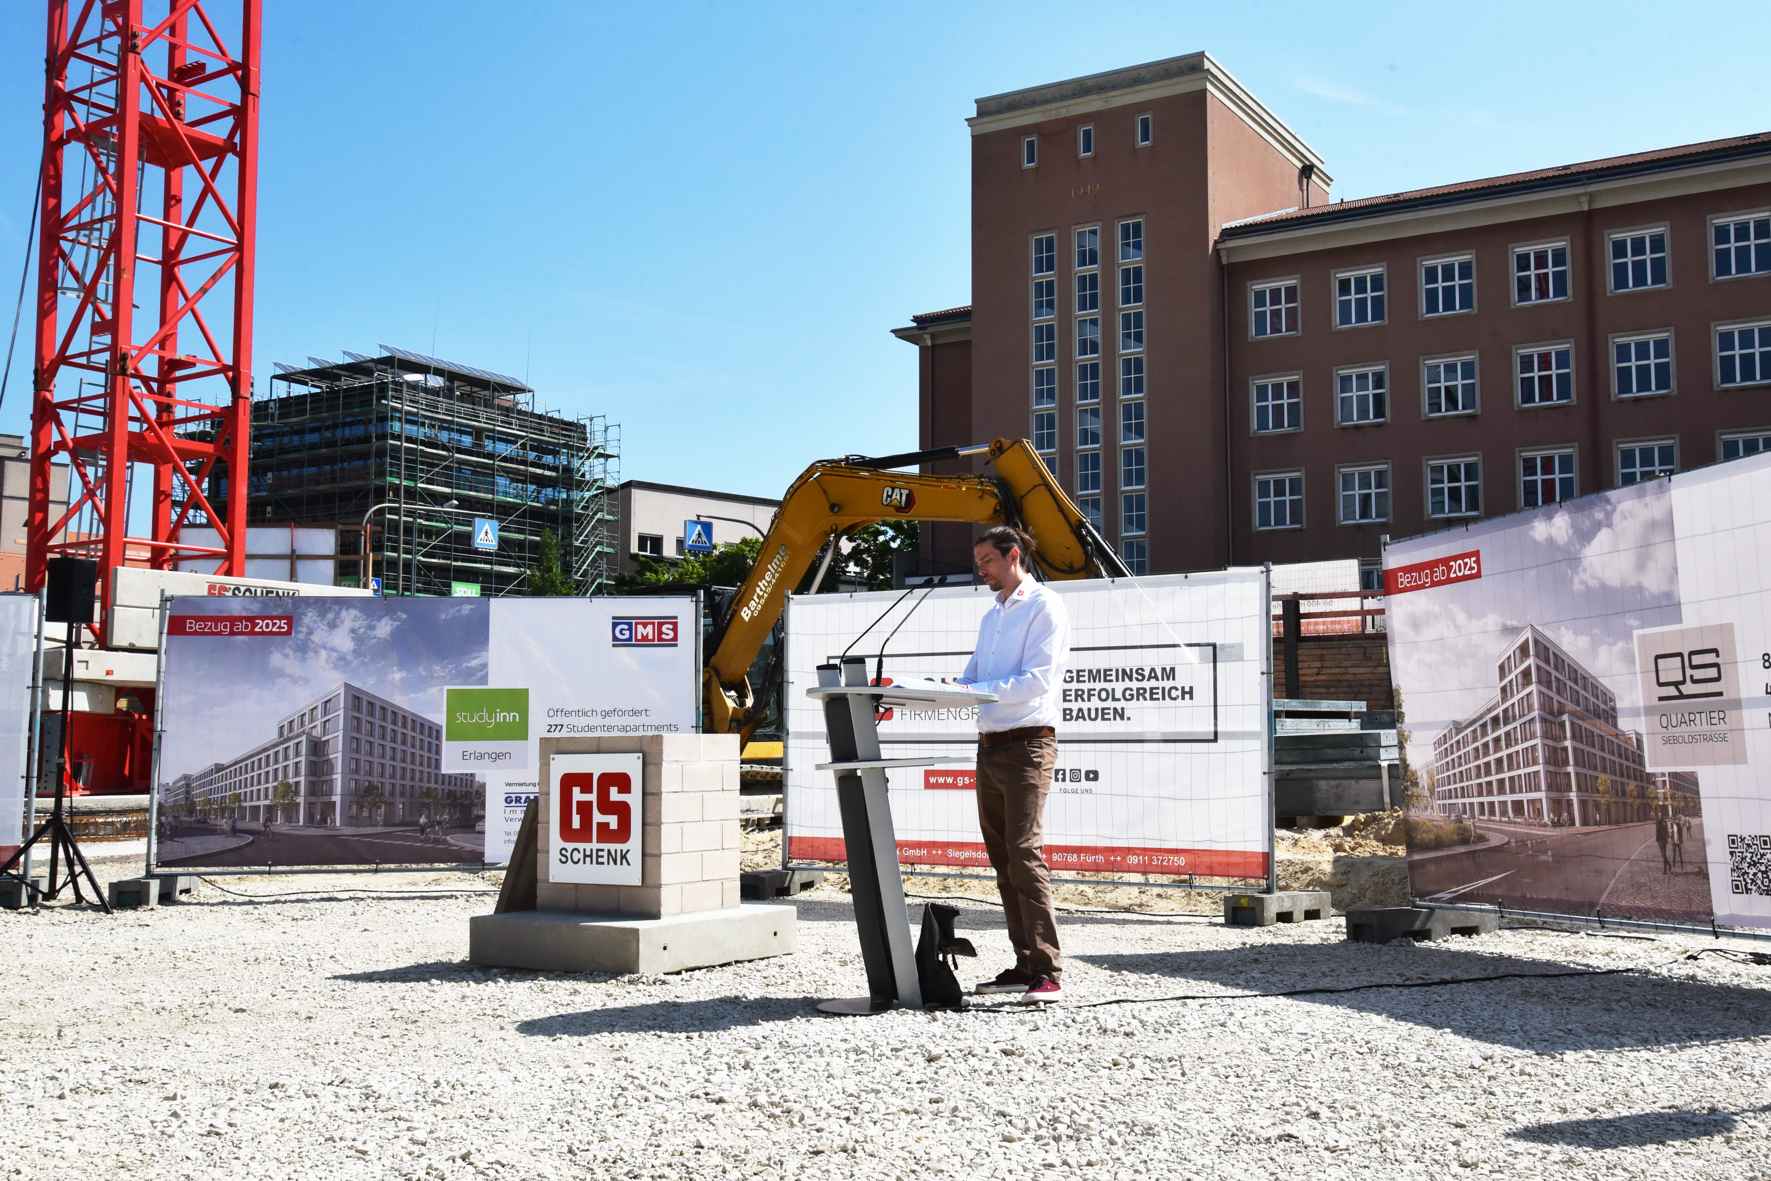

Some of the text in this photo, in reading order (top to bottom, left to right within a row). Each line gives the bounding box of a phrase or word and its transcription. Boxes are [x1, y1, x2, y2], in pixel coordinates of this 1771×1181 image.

[883, 487, 909, 507] CAT
[1398, 557, 1478, 588] Bezug ab 2025
[186, 619, 289, 634] Bezug ab 2025
[614, 624, 674, 639] GMS
[1063, 667, 1176, 684] GEMEINSAM
[1654, 648, 1722, 698] QS
[1062, 686, 1194, 703] ERFOLGREICH
[455, 705, 520, 728] studyinn
[1062, 707, 1131, 722] BAUEN.
[1660, 710, 1728, 730] QUARTIER
[547, 722, 680, 734] 277 Studentenapartments
[1661, 732, 1729, 746] SIEBOLDSTRASSE
[462, 750, 512, 763] Erlangen
[504, 795, 539, 805] GRA
[560, 772, 631, 844] GS
[559, 847, 631, 866] SCHENK
[903, 847, 928, 857] GmbH
[1051, 852, 1078, 862] 90768
[1127, 855, 1149, 865] 0911
[1152, 855, 1186, 866] 372750
